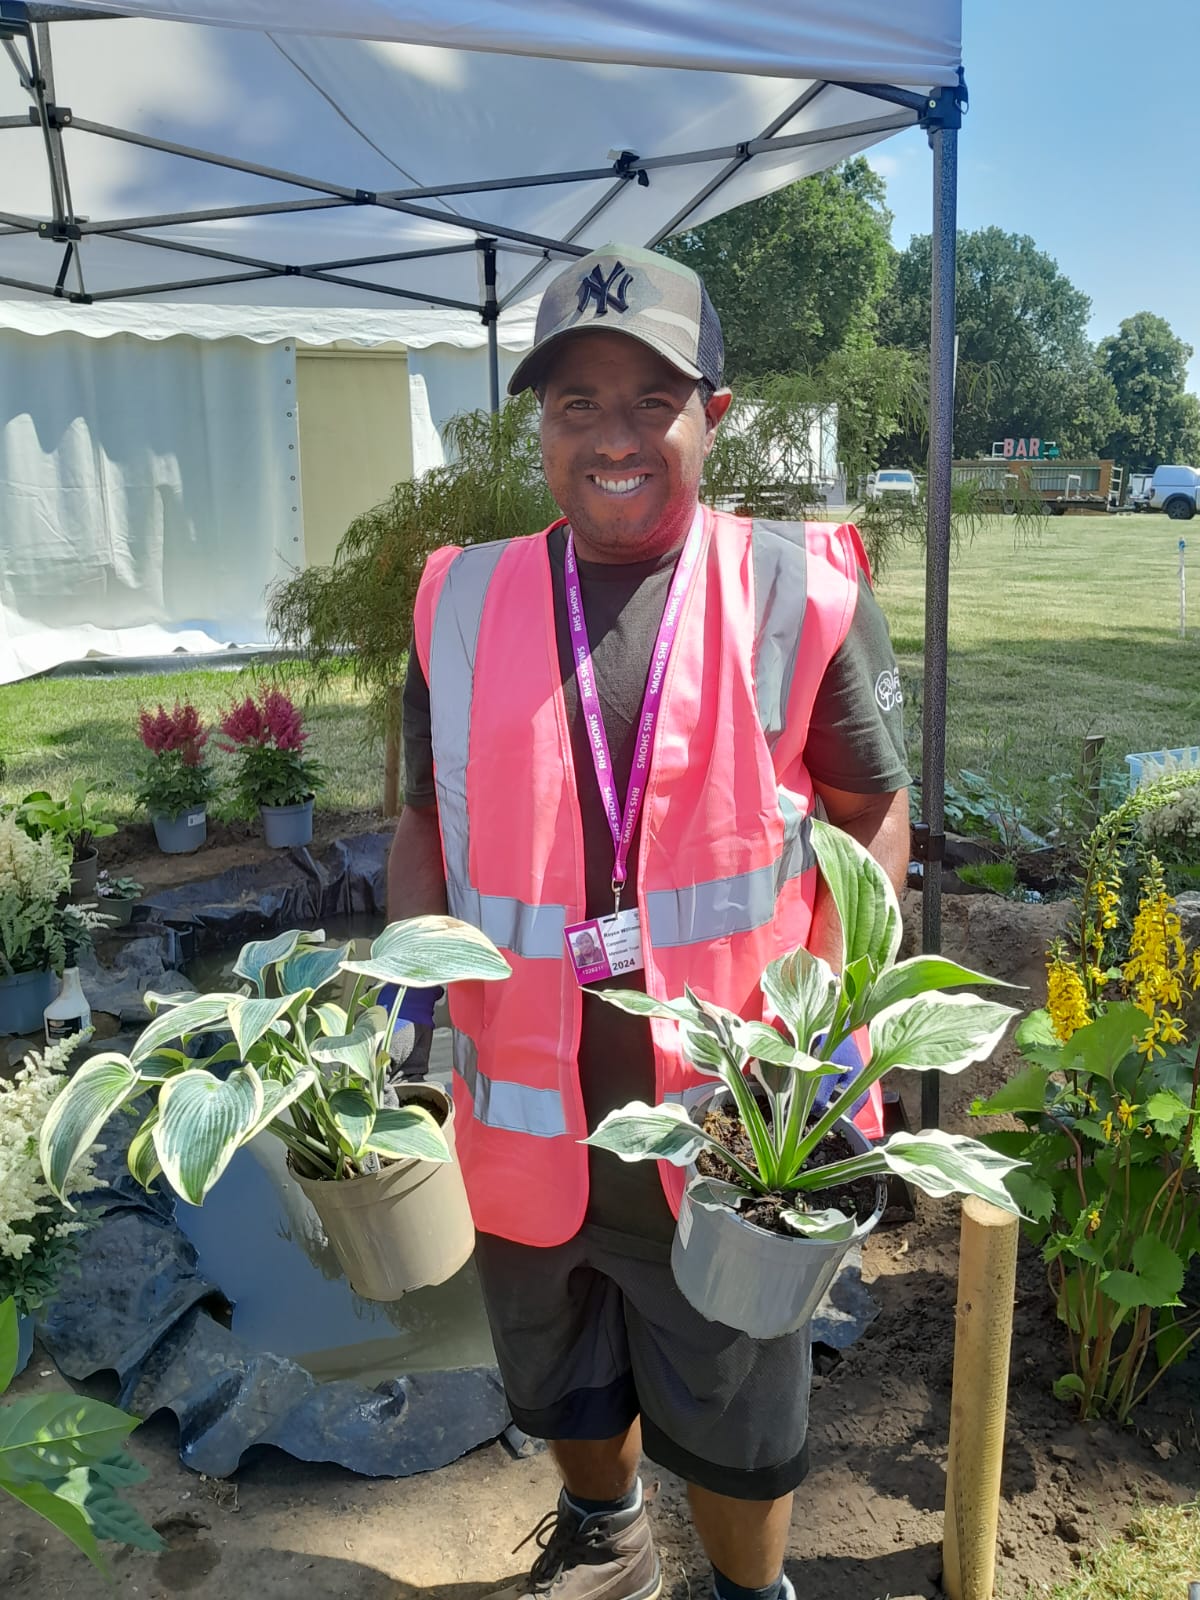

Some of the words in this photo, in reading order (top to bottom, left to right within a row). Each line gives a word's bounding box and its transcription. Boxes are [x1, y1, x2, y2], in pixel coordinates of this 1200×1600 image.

[576, 261, 634, 315] NY
[1003, 437, 1041, 458] BAR
[569, 586, 580, 615] SHOWS
[666, 597, 681, 627] SHOWS
[573, 614, 582, 632] RHS
[577, 646, 589, 678] SHOWS
[657, 641, 669, 660] RHS
[582, 680, 593, 698] RHS
[650, 660, 666, 694] SHOWS
[588, 713, 603, 749] SHOWS
[642, 712, 654, 732] RHS
[596, 750, 608, 769] RHS
[637, 733, 651, 769] SHOWS
[604, 786, 618, 822] SHOWS
[629, 786, 641, 807] RHS
[623, 808, 636, 844] SHOWS
[612, 957, 636, 971] 2024
